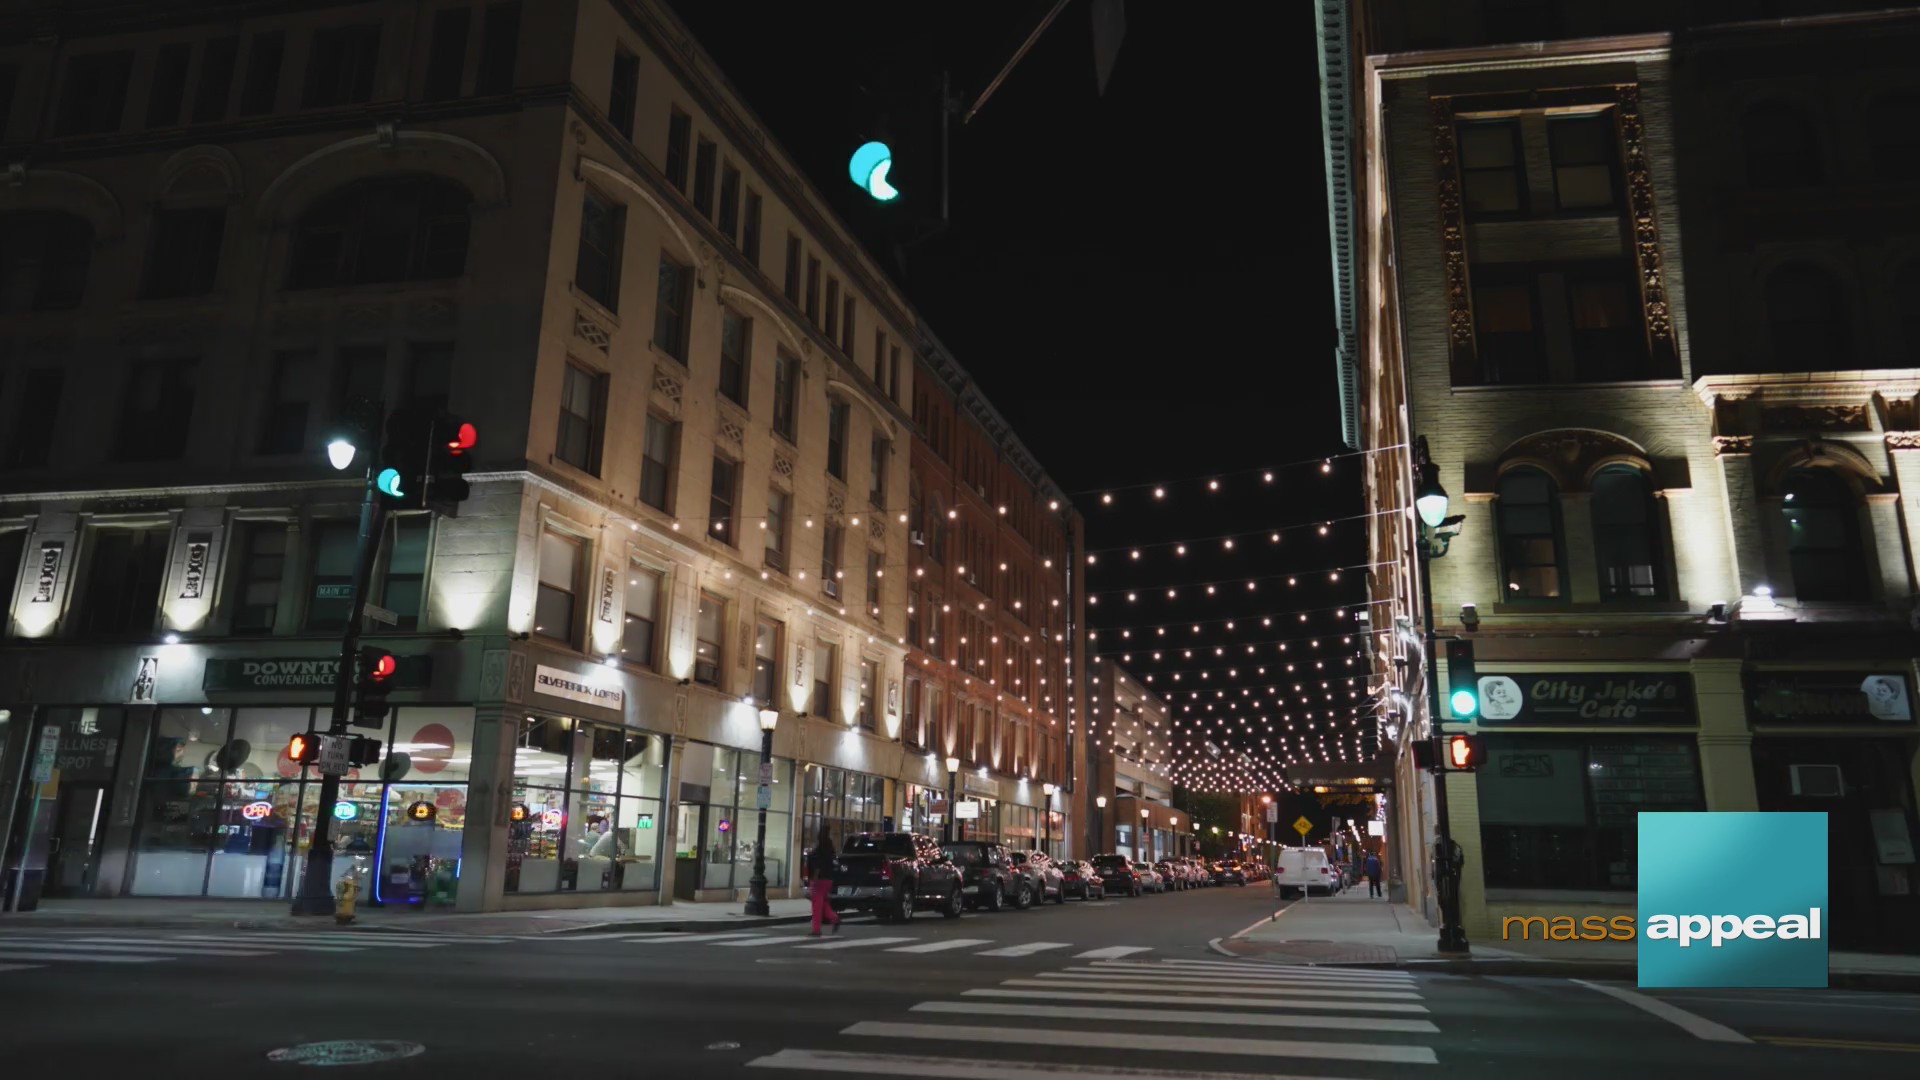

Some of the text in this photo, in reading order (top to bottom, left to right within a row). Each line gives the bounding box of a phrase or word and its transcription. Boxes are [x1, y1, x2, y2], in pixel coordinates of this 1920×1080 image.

[320, 587, 340, 596] MAIN
[254, 674, 335, 686] CONVENIENCE
[538, 674, 621, 701] SILVERBRICK LOFTS
[1531, 679, 1676, 704] City Jake's
[1579, 699, 1638, 719] Cafe
[70, 720, 96, 734] THE
[332, 741, 343, 750] NO
[328, 751, 344, 760] TURN
[57, 756, 95, 769] SPOT
[243, 805, 271, 817] OPEN
